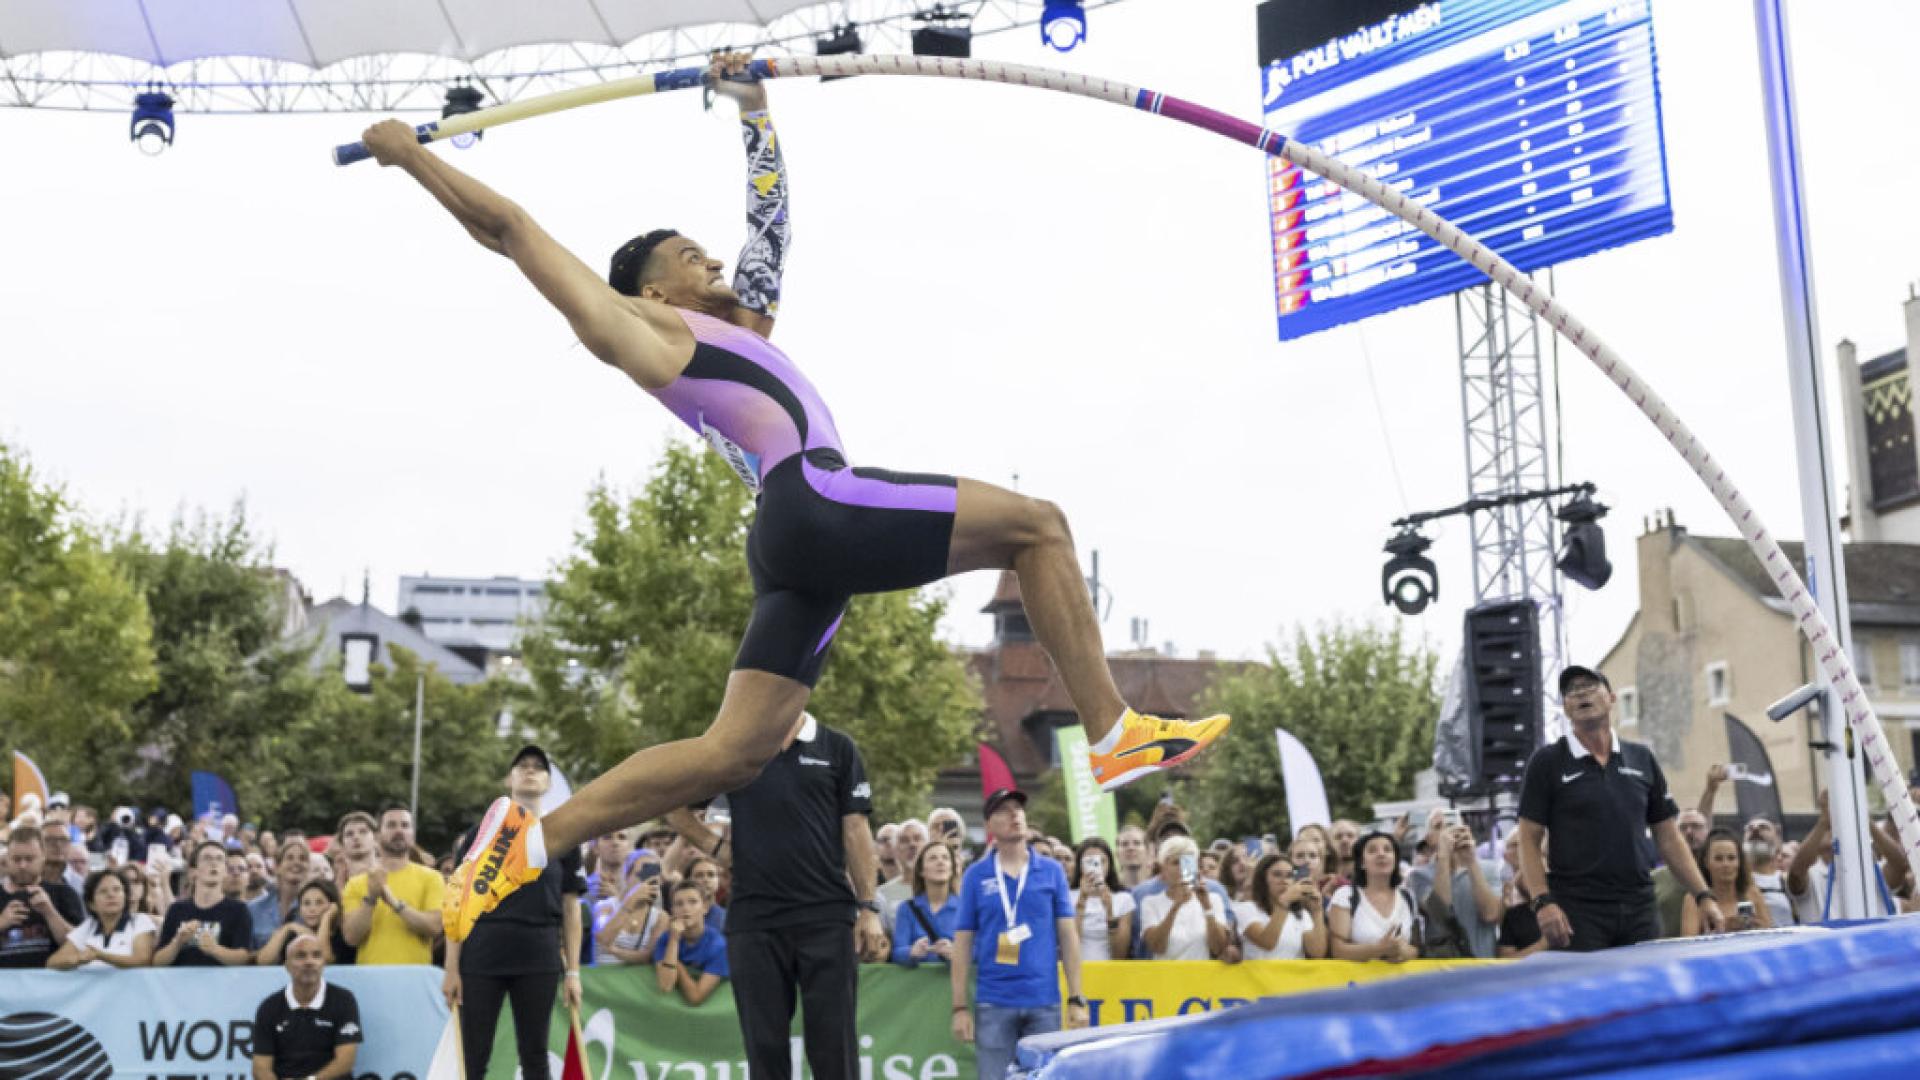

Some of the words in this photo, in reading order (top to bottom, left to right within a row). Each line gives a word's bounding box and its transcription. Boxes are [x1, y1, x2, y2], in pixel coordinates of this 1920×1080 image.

[1292, 38, 1340, 80] POLE
[1339, 15, 1397, 60] VAULT
[1397, 2, 1441, 40] MEN
[139, 1020, 256, 1061] WOR
